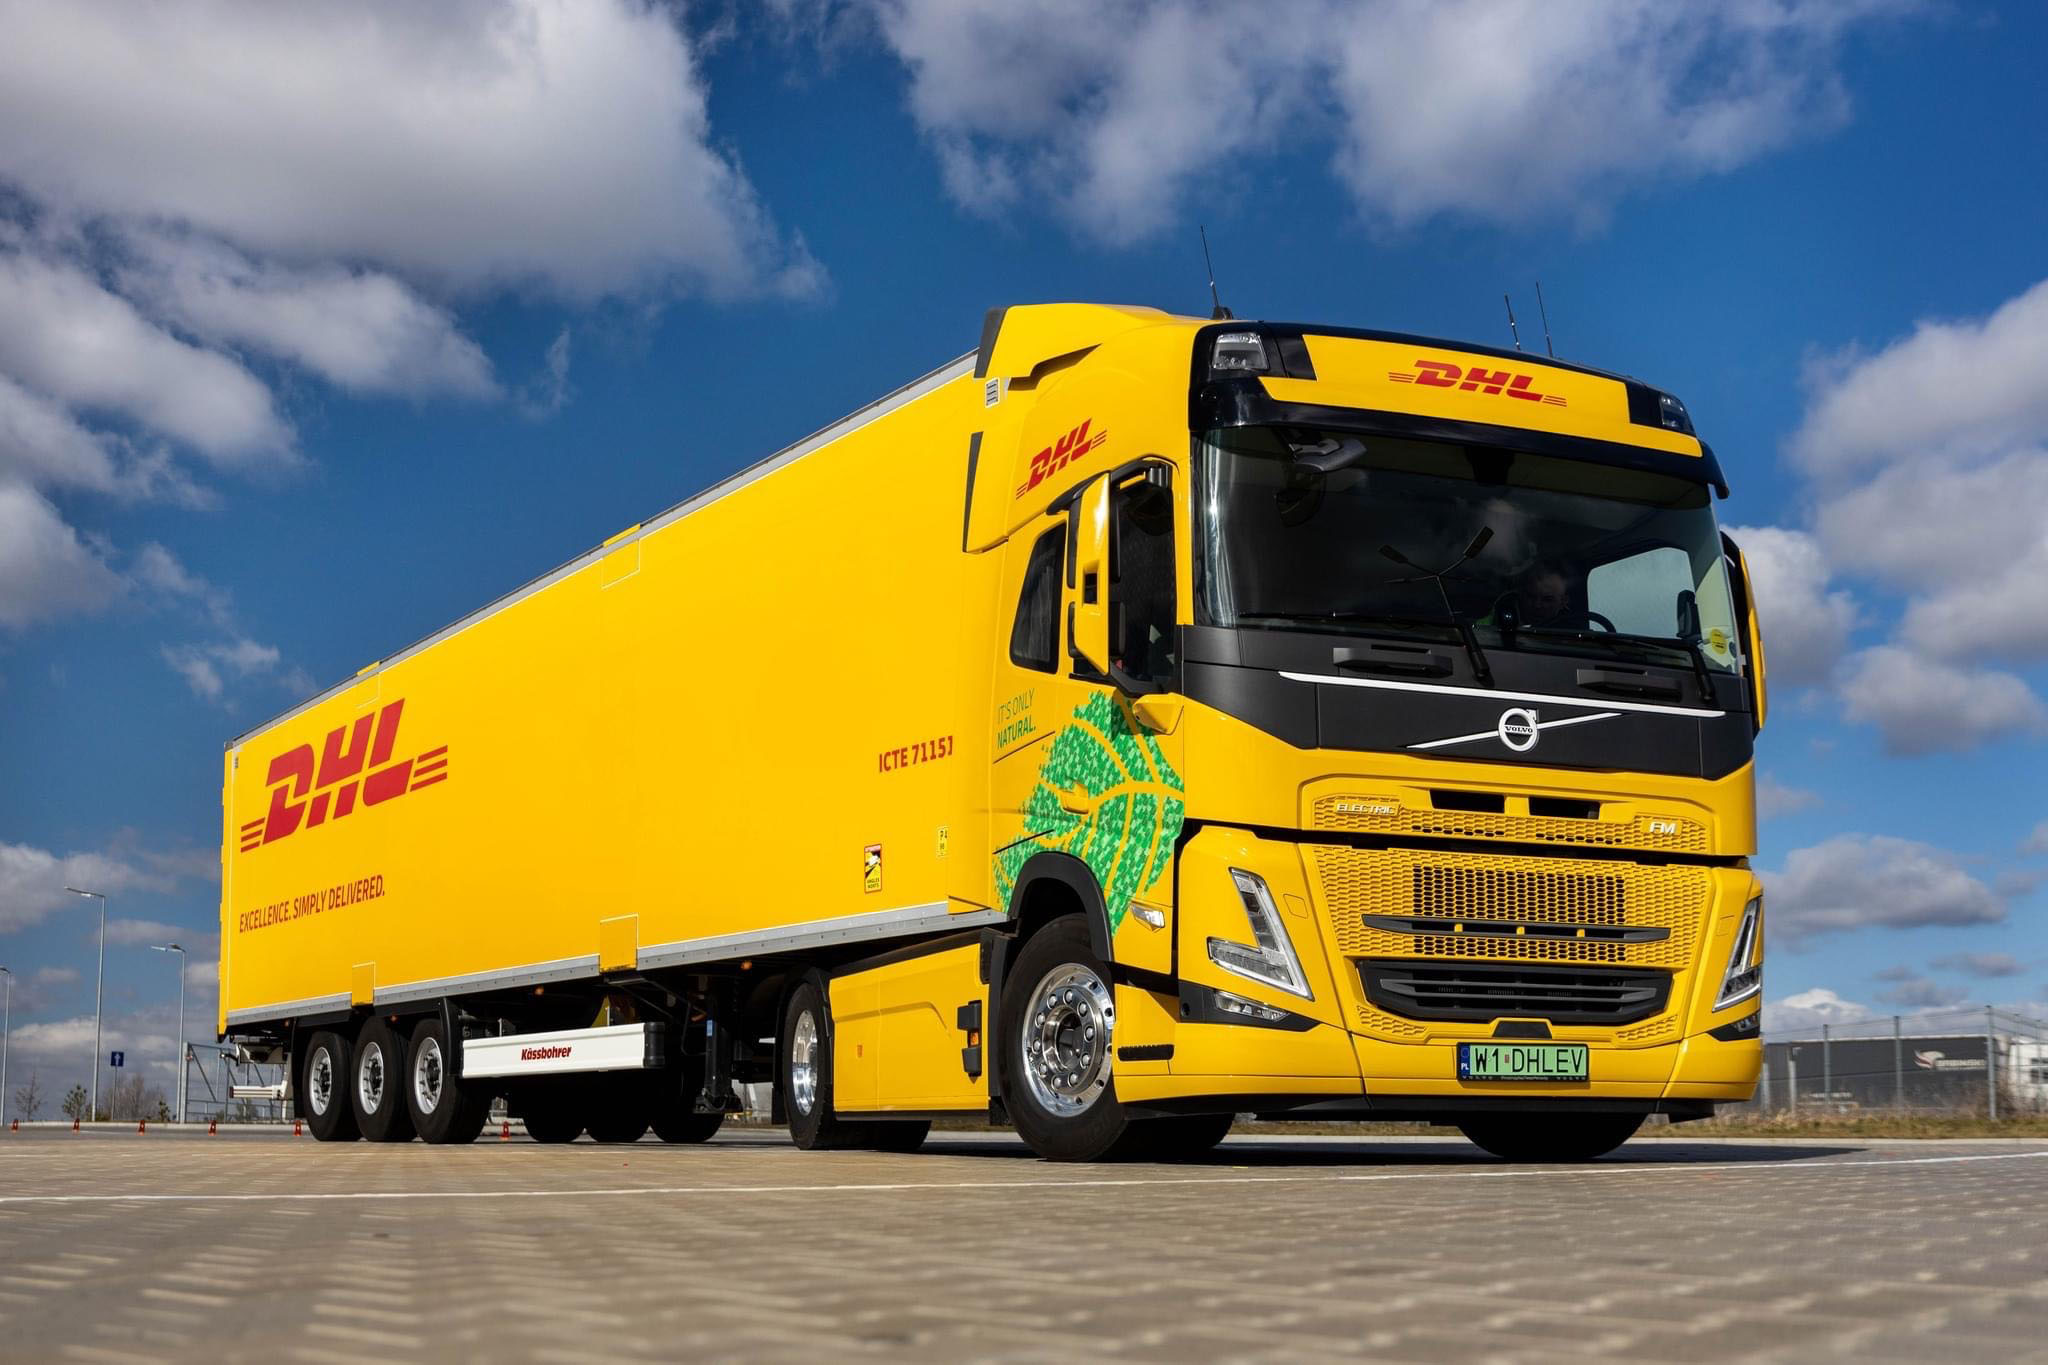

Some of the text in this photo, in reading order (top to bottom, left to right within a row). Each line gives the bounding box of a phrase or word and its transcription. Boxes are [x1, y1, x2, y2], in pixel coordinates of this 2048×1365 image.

[1414, 359, 1544, 402] DHL
[1026, 418, 1093, 493] DHL
[997, 688, 1035, 725] IT'S ONLY
[997, 714, 1036, 750] NATURAL.
[1505, 725, 1534, 733] VOLVO
[262, 698, 414, 846] DHL
[879, 735, 954, 773] ICTE 71151
[1336, 803, 1396, 815] ELECTRIC
[1649, 821, 1677, 834] FM
[239, 874, 385, 934] EXCELLENCE. SIMPLY DELIVERED.
[521, 1046, 572, 1061] Kässbohrer
[1475, 1048, 1583, 1072] W1 DHLEV
